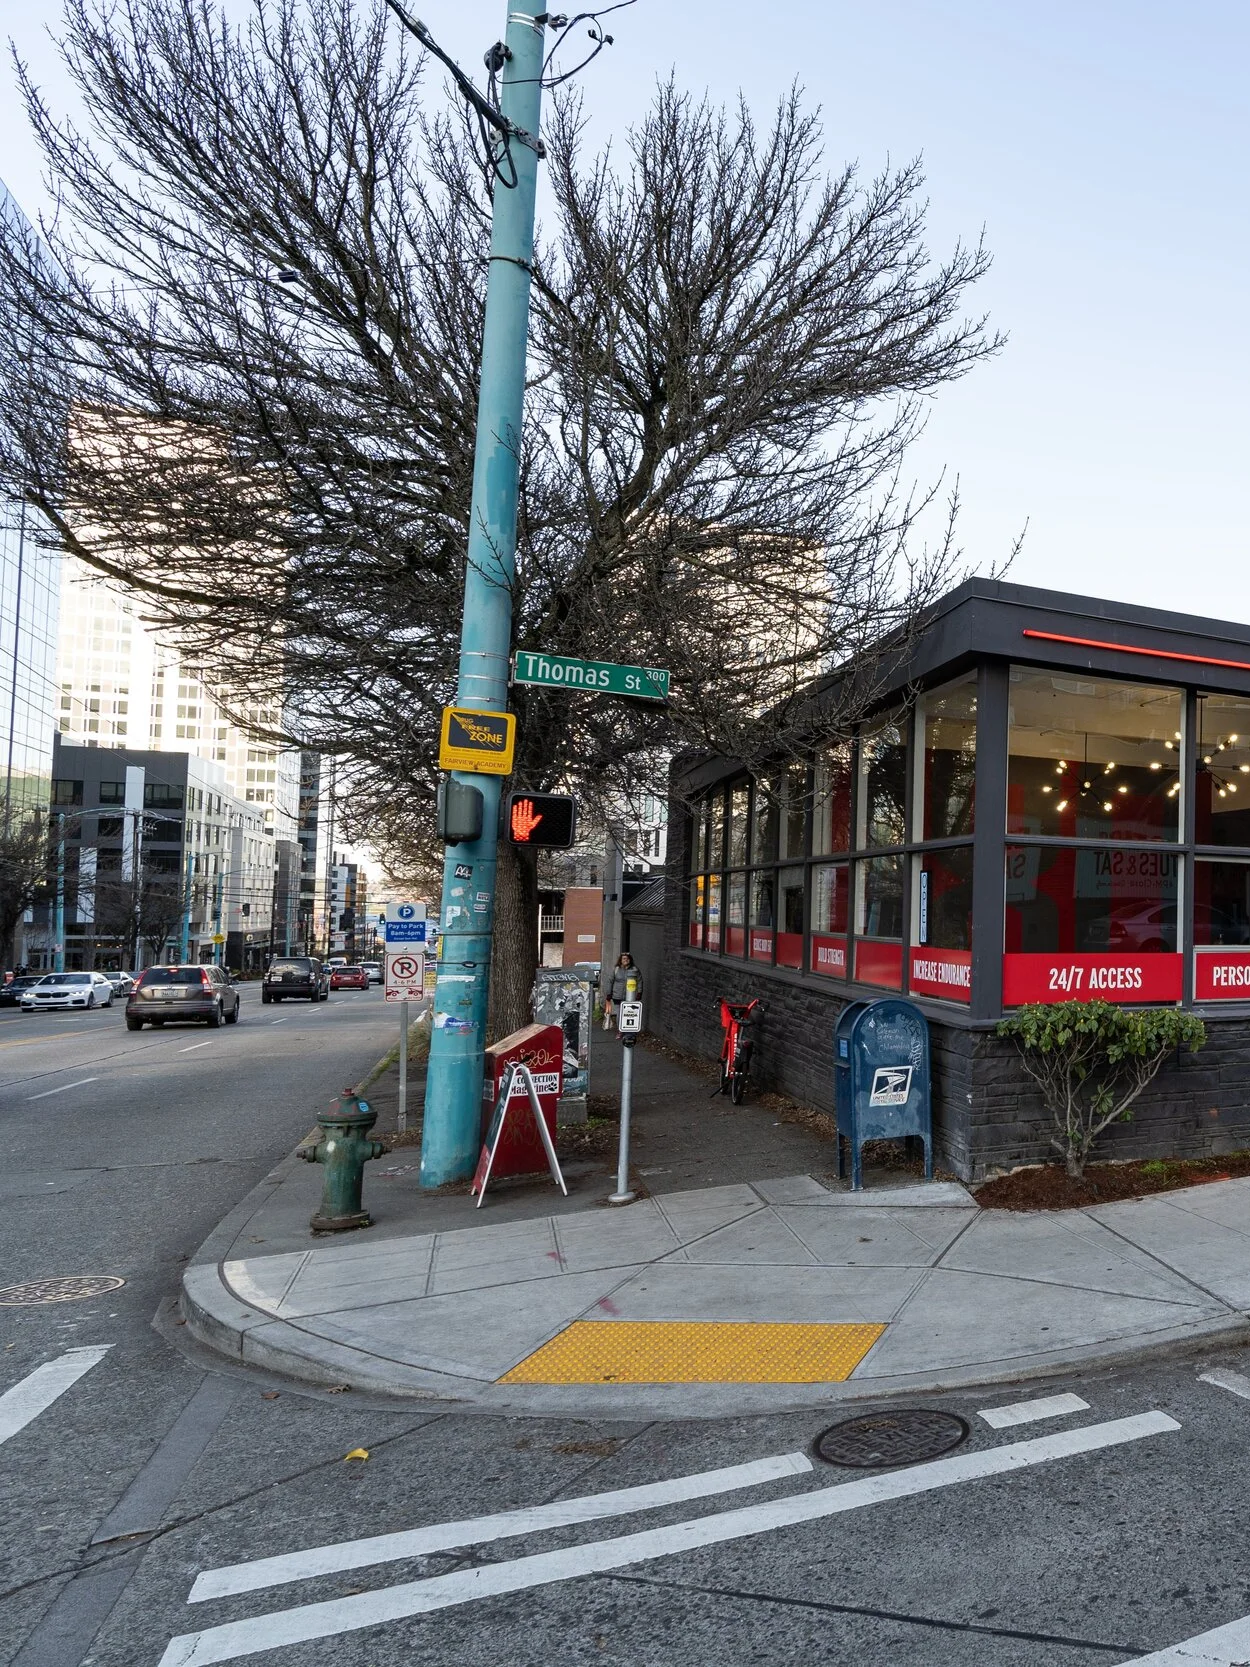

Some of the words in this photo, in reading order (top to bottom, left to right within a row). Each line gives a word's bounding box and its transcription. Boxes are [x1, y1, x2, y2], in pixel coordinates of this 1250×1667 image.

[525, 655, 610, 687] Thomas
[625, 674, 641, 690] St
[646, 670, 666, 682] 300
[470, 731, 503, 744] ZONE
[444, 757, 474, 766] FAIRVIEW
[476, 760, 507, 769] ACADEMY
[388, 923, 400, 931] Pay
[913, 959, 938, 982] INCREASE
[938, 962, 971, 988] ENDURANCE
[1049, 965, 1084, 992] 24/7
[1088, 967, 1143, 989] ACCESS
[517, 1074, 558, 1085] COECTION
[511, 1082, 549, 1095] Magine
